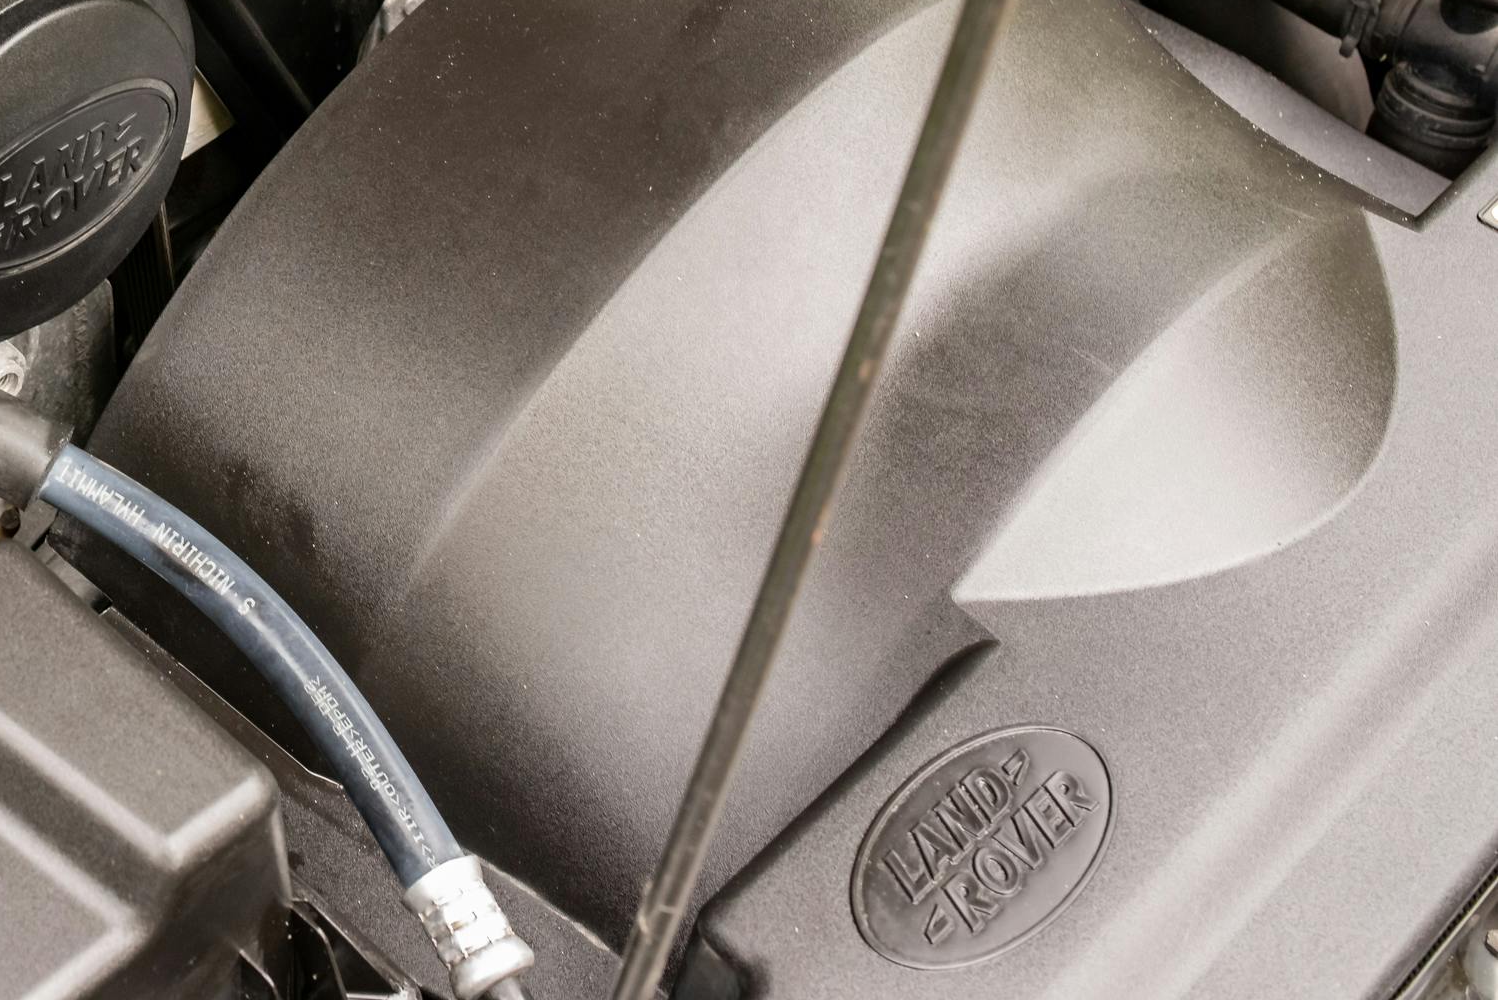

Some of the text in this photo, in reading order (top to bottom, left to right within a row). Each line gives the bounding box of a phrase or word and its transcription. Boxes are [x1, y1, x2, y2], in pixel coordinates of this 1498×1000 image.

[150, 520, 237, 595] NICHIRIN
[884, 767, 1014, 904] LAND
[942, 770, 1100, 934] ROVER
